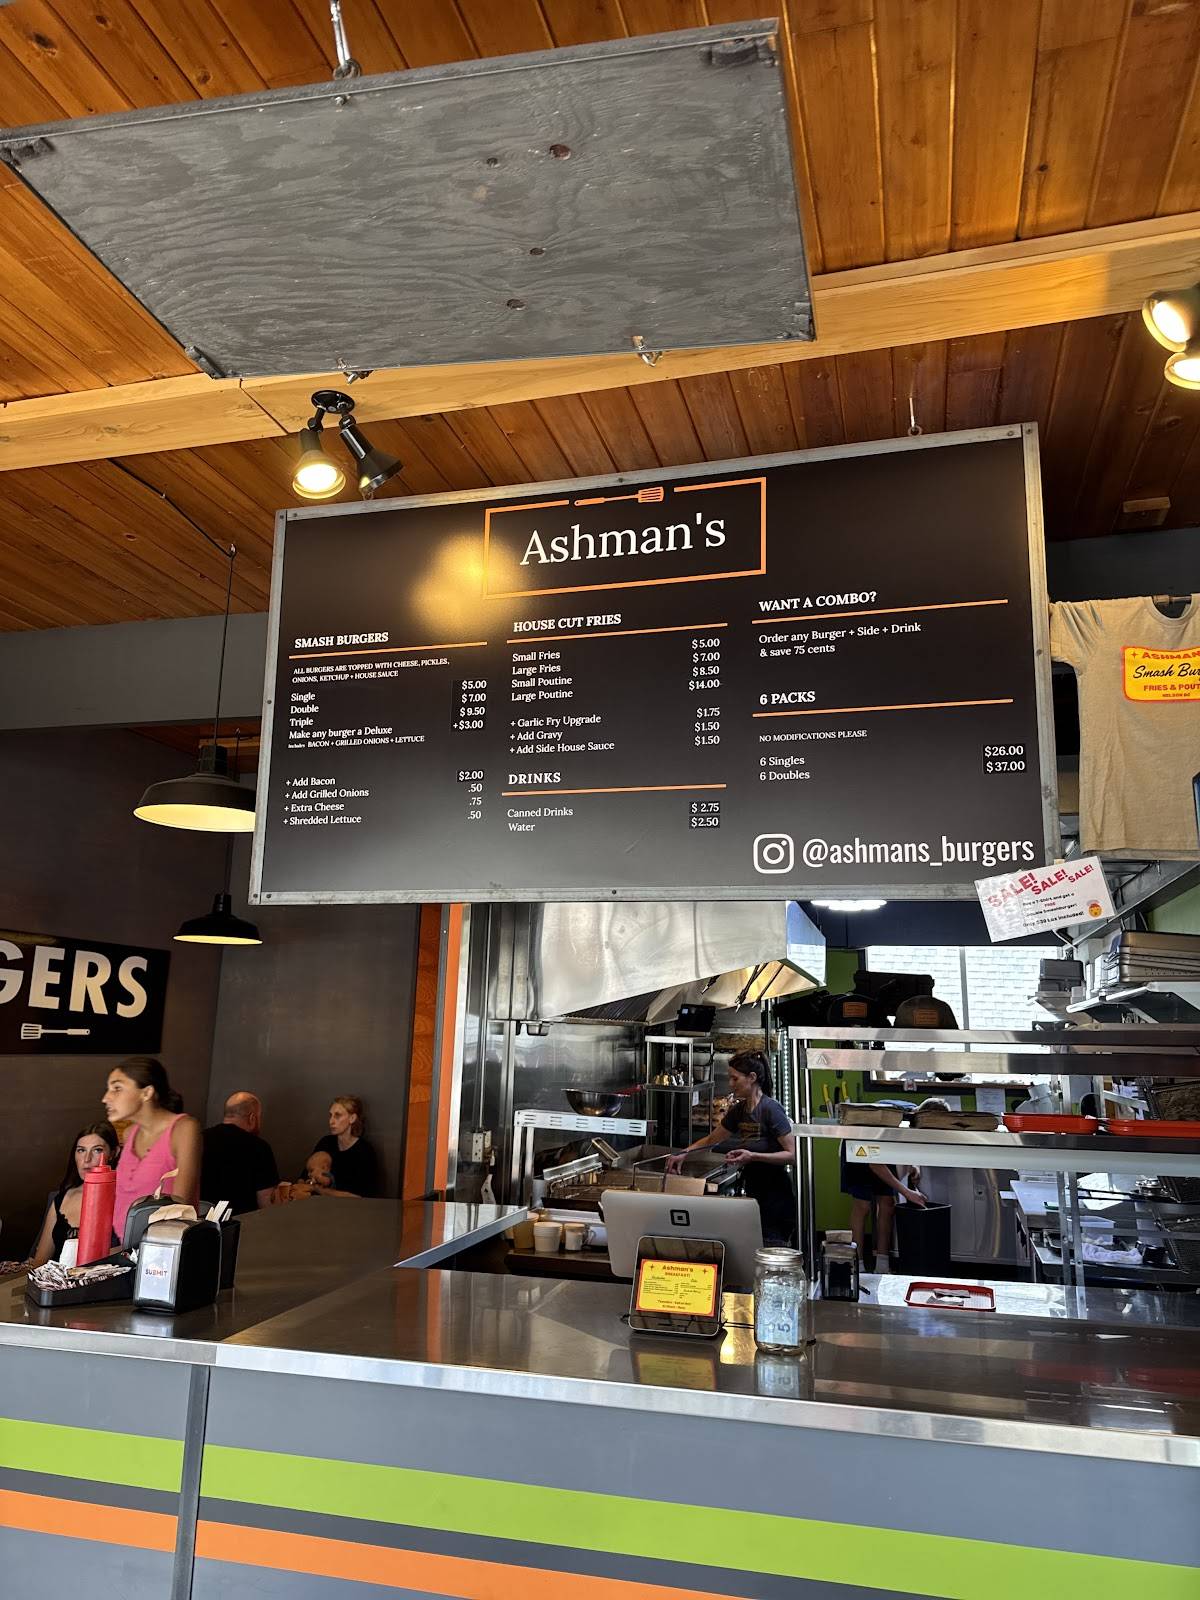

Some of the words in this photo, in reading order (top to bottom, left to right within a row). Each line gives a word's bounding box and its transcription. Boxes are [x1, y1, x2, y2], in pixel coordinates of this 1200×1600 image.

[520, 512, 726, 565] Ashman's
[759, 599, 800, 612] WANT
[802, 598, 813, 609] A
[816, 592, 877, 607] COMBO?
[513, 620, 555, 632] HOUSE
[558, 617, 583, 628] CUT
[586, 614, 621, 627] FRIES
[759, 634, 788, 644] Order
[790, 632, 809, 642] any
[812, 629, 846, 640] Burger
[857, 626, 879, 636] Side
[891, 623, 921, 633] Drink
[295, 636, 333, 648] SMASH
[337, 632, 389, 645] BURGERS
[692, 638, 720, 649] $5.00
[760, 648, 768, 657] &
[770, 647, 791, 656] save
[794, 646, 805, 655] 75
[807, 644, 835, 653] cents
[513, 652, 536, 662] Small
[539, 651, 560, 660] Fries
[306, 666, 334, 674] BURGERS
[421, 658, 450, 666] PICKLES,
[512, 665, 537, 676] Large
[539, 664, 560, 673] Fries
[320, 673, 349, 682] KETCHUP
[1133, 664, 1174, 678] Smash
[1177, 663, 1200, 681] Bur
[462, 680, 486, 690] $5.00
[512, 679, 536, 688] Small
[538, 677, 572, 686] Poutine
[689, 679, 719, 690] $14.00
[291, 692, 315, 703] Single
[512, 692, 536, 703] Large
[539, 690, 573, 699] Poutine
[760, 694, 767, 705] 6
[771, 691, 815, 704] PACKS
[291, 705, 319, 714] Double
[697, 707, 720, 718] $1.75
[290, 718, 313, 728] Triple
[453, 720, 483, 729] +$3.00
[518, 718, 544, 727] Garlic
[546, 717, 561, 727] Fry
[563, 715, 601, 726] Upgrade
[289, 730, 310, 739] Make
[312, 730, 327, 738] any
[328, 728, 355, 738] burger
[364, 726, 392, 735] Deluxe
[695, 722, 719, 732] $1.50
[363, 737, 389, 745] ONIONS
[395, 735, 424, 743] LETTUCE
[517, 732, 535, 741] Add
[537, 731, 563, 741] Gravy
[695, 736, 719, 746] $1.50
[773, 731, 836, 741] MODIFICATIONS
[838, 730, 867, 738] PLEASE
[516, 745, 534, 754] Add
[536, 744, 555, 753] Side
[557, 742, 585, 752] House
[588, 741, 614, 750] Sauce
[985, 745, 1023, 757] $26.00
[760, 756, 766, 767] 6
[769, 756, 805, 768] Singles
[459, 771, 483, 781] $2.00
[508, 773, 561, 785] DRINKS
[760, 771, 766, 781] 6
[769, 770, 810, 780] Doubles
[292, 778, 308, 786] Add
[311, 778, 335, 786] Bacon
[292, 791, 308, 799] Add
[309, 789, 337, 799] Grilled
[339, 789, 369, 798] Onions
[468, 784, 482, 793] .50
[291, 804, 312, 812] Extra
[315, 802, 344, 811] Cheese
[507, 808, 541, 818] Canned
[544, 807, 573, 817] Drinks
[289, 816, 328, 826] Shredded
[330, 815, 361, 824] Lettuce
[467, 811, 481, 819] .50
[508, 823, 535, 832] Water
[691, 817, 718, 827] $2.50
[803, 835, 1034, 867] @ashmans_burgers
[1068, 864, 1094, 883] SALE!
[1032, 869, 1068, 895] SALE!
[988, 873, 1037, 907] SALE!
